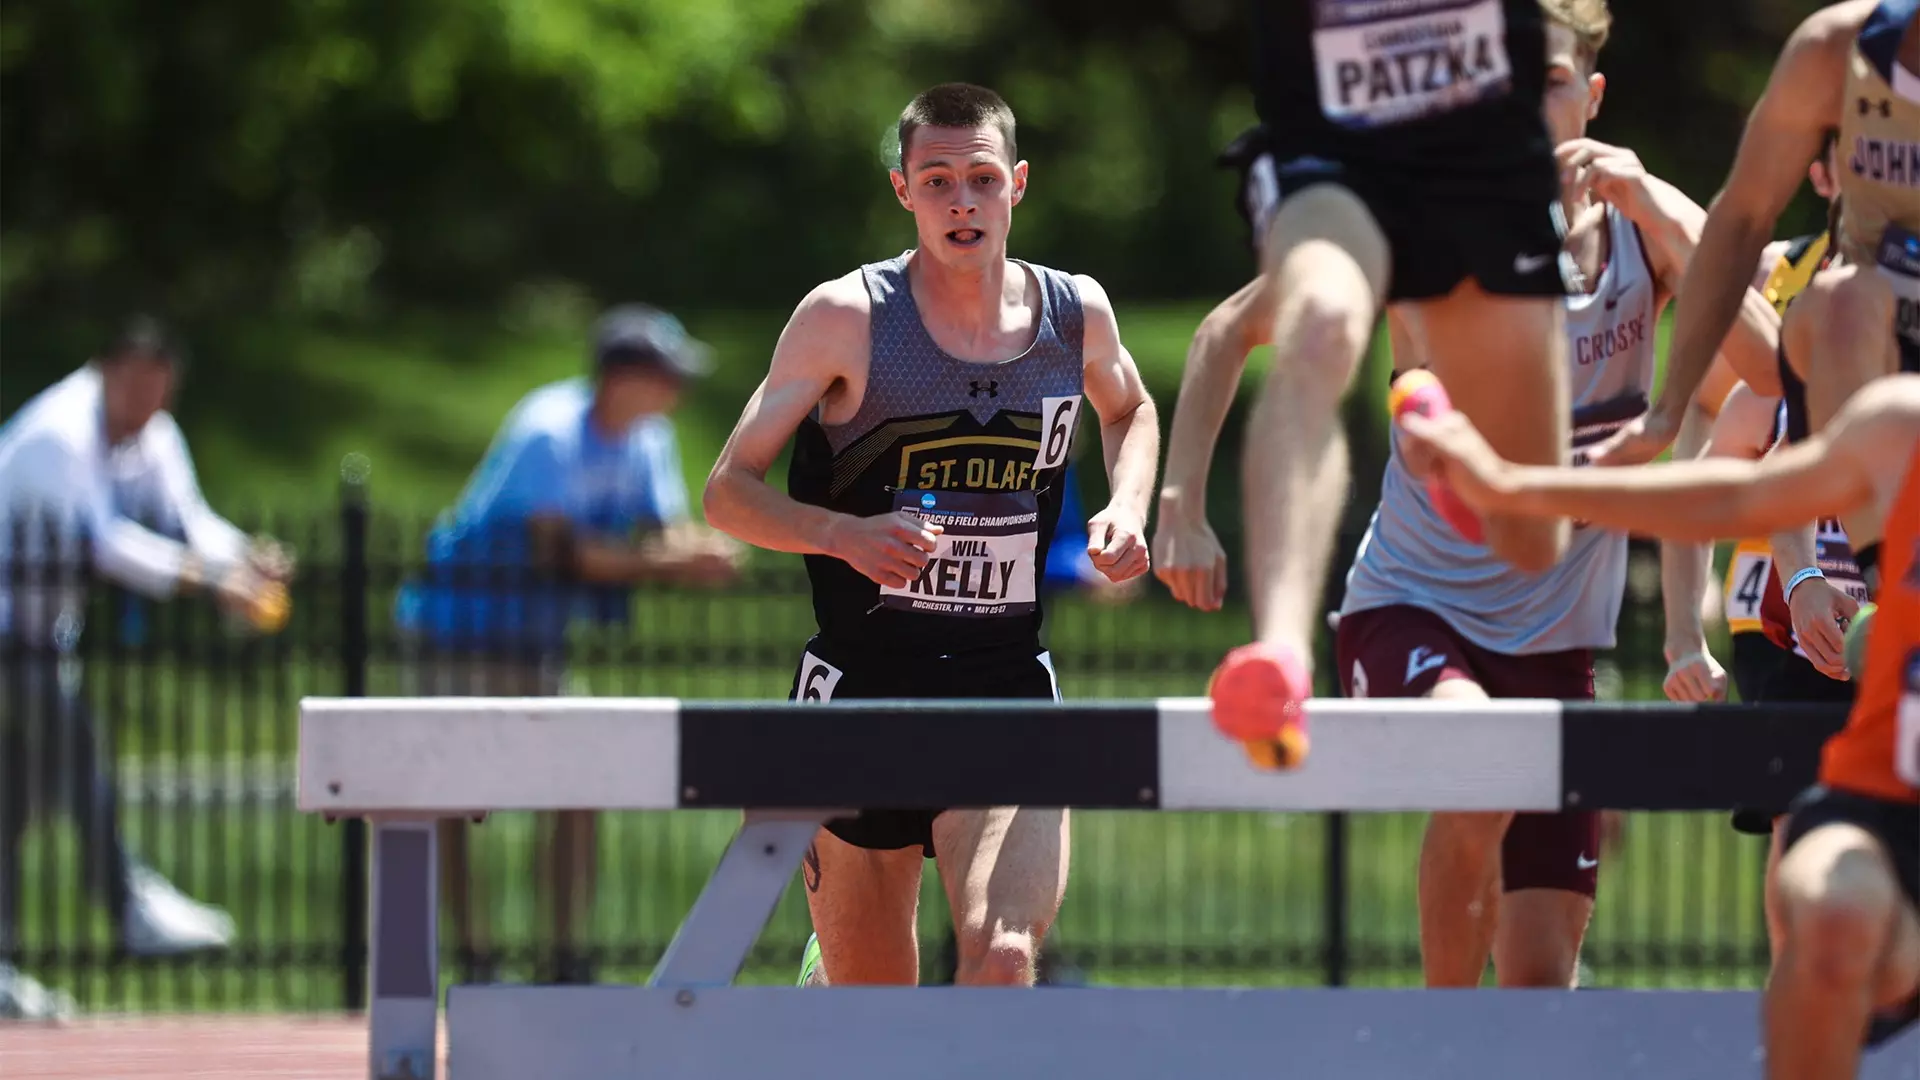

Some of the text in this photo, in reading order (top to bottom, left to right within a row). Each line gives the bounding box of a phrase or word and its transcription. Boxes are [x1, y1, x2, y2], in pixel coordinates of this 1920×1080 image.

[1337, 35, 1494, 105] PATZKA
[1576, 313, 1646, 366] CROSSE
[1044, 400, 1073, 465] 6
[917, 457, 1033, 491] ST. OLAF
[919, 513, 948, 525] TRACK
[948, 515, 955, 525] &
[955, 516, 978, 526] FIELD
[979, 512, 1038, 527] CHAMPIONSHIPS
[952, 540, 989, 557] WILL
[909, 557, 1016, 600] KELLY
[1737, 560, 1766, 615] 4
[912, 600, 952, 612] ROCHESTER,
[953, 604, 964, 613] NY
[974, 605, 990, 614] MAY
